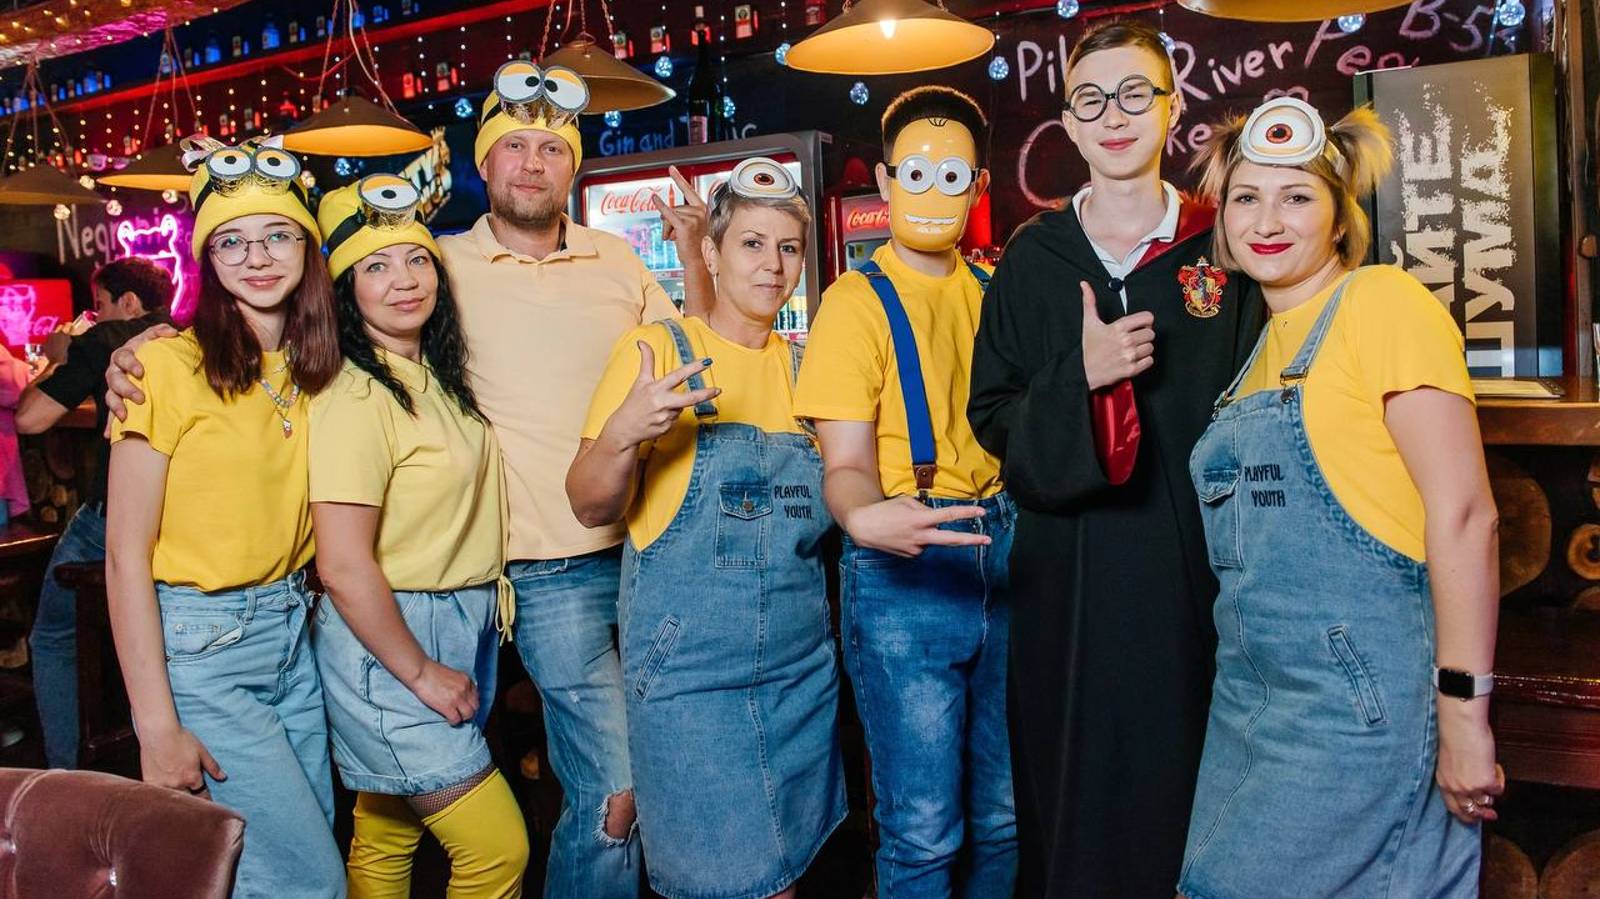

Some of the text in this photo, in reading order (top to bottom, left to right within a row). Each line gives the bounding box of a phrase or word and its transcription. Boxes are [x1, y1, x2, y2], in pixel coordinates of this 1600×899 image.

[1167, 40, 1294, 113] River
[599, 128, 635, 157] Gin
[640, 118, 676, 152] and
[1244, 463, 1285, 482] PLAYFUL
[774, 485, 812, 499] PLAYFUL
[1251, 489, 1286, 507] YOUTH
[784, 505, 812, 519] YOUTH
